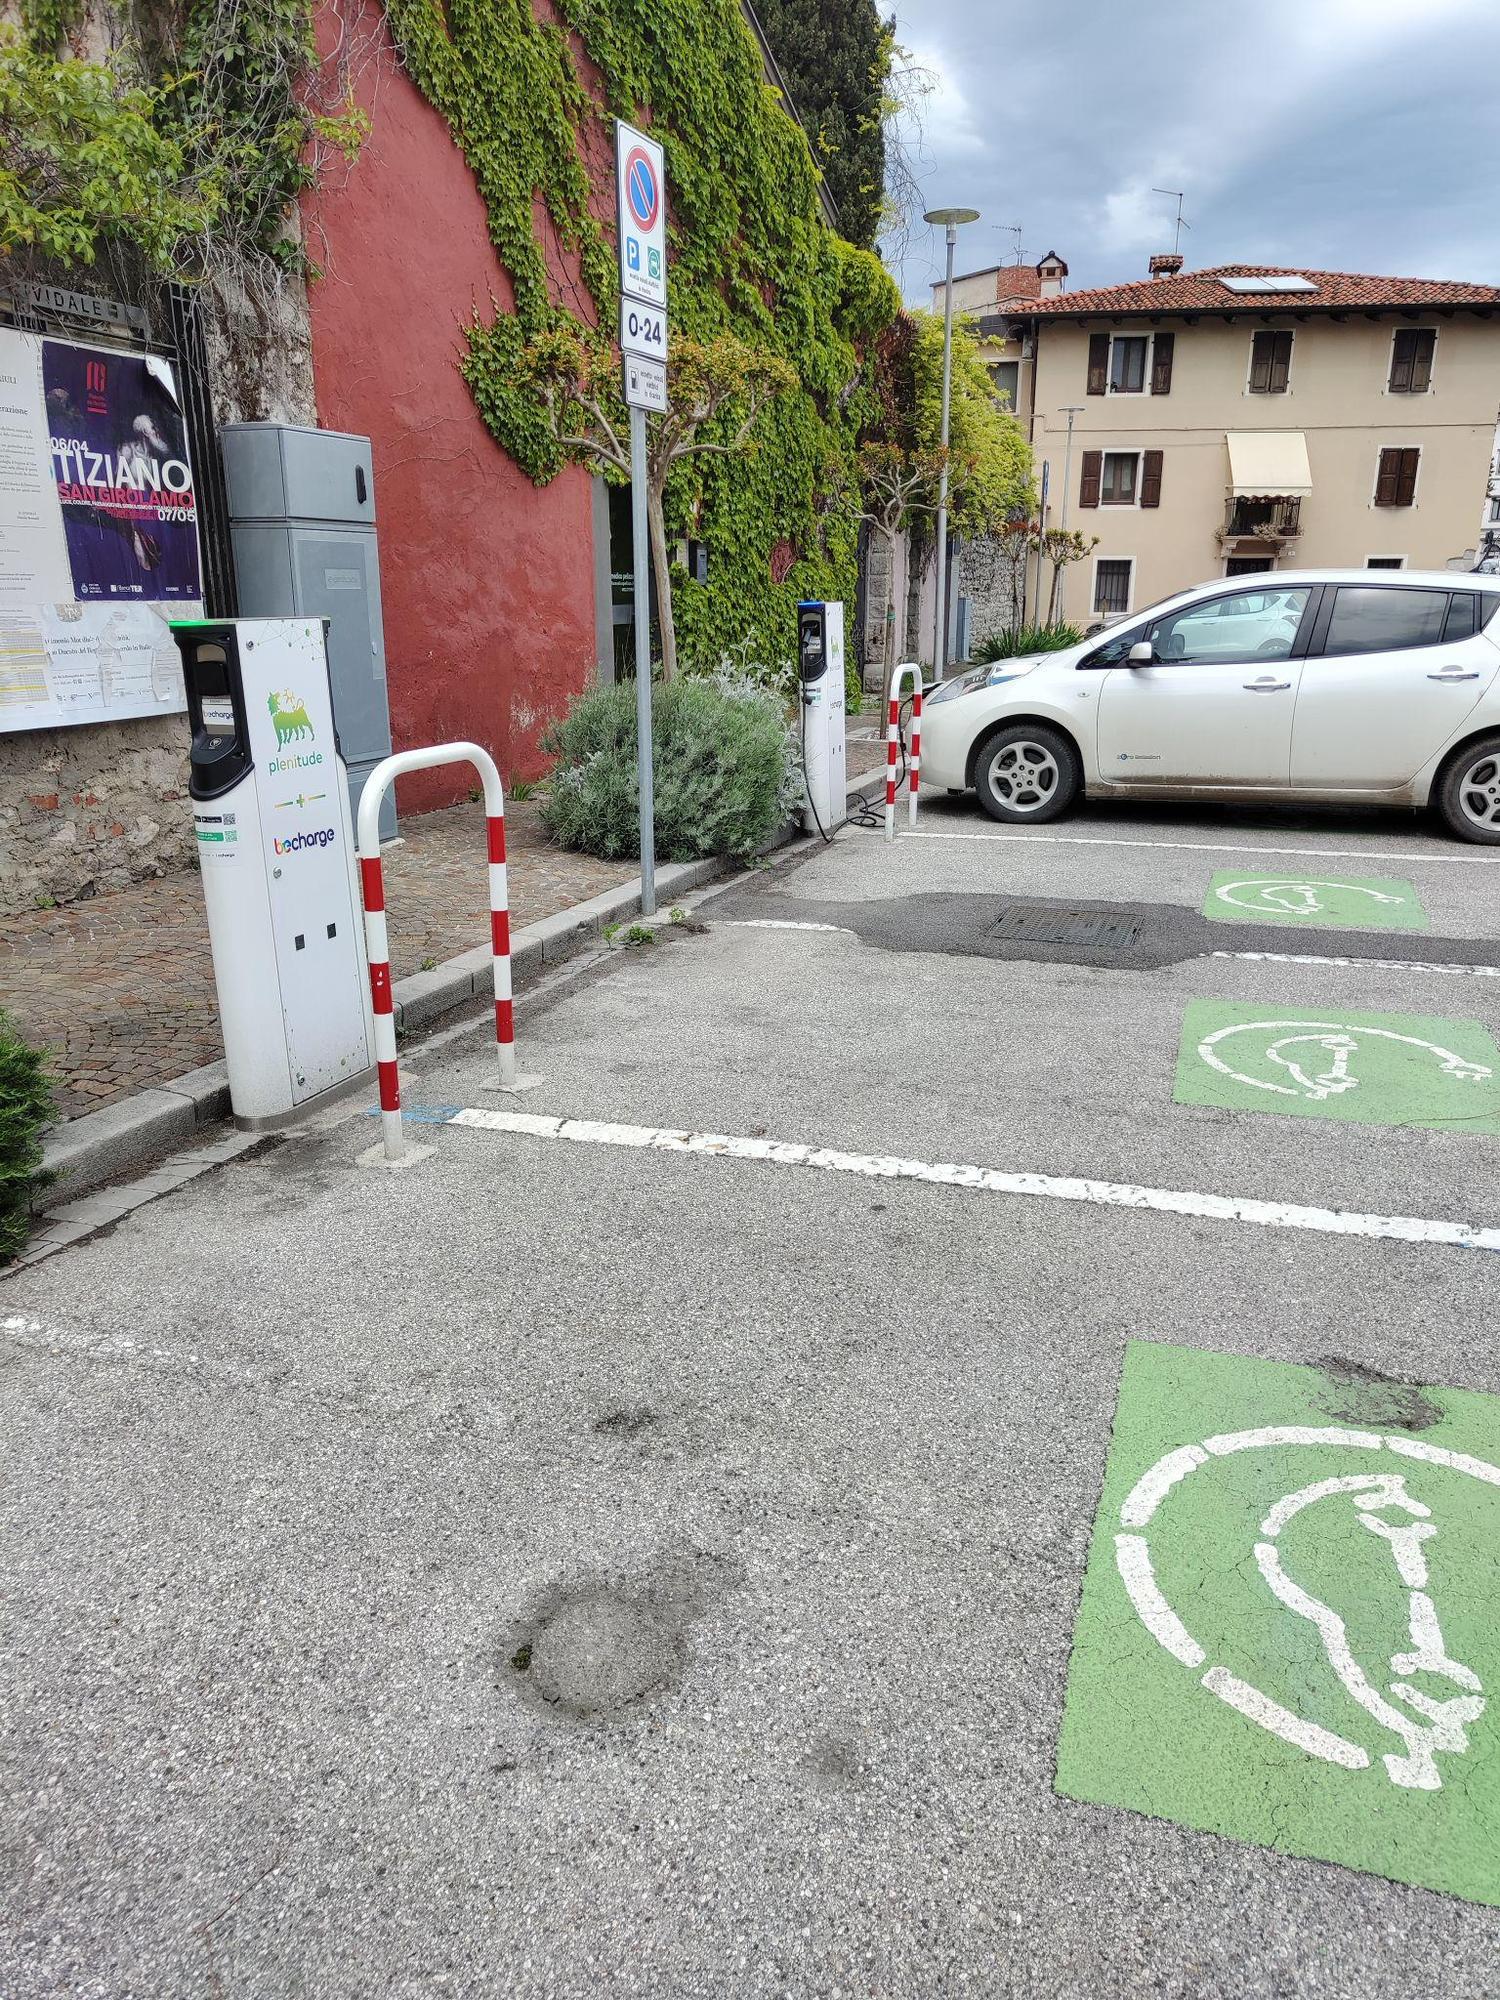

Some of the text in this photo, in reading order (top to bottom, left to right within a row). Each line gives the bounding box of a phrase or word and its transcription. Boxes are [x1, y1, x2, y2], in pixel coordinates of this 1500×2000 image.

[629, 241, 637, 265] P
[629, 313, 661, 345] 0-24
[51, 437, 89, 452] 06/04
[51, 449, 193, 493] TIZIANO
[57, 481, 97, 502] SAN
[98, 487, 196, 508] GIROLAMO
[158, 509, 196, 522] 07/05
[269, 752, 323, 776] plenitude
[273, 828, 335, 856] becharge
